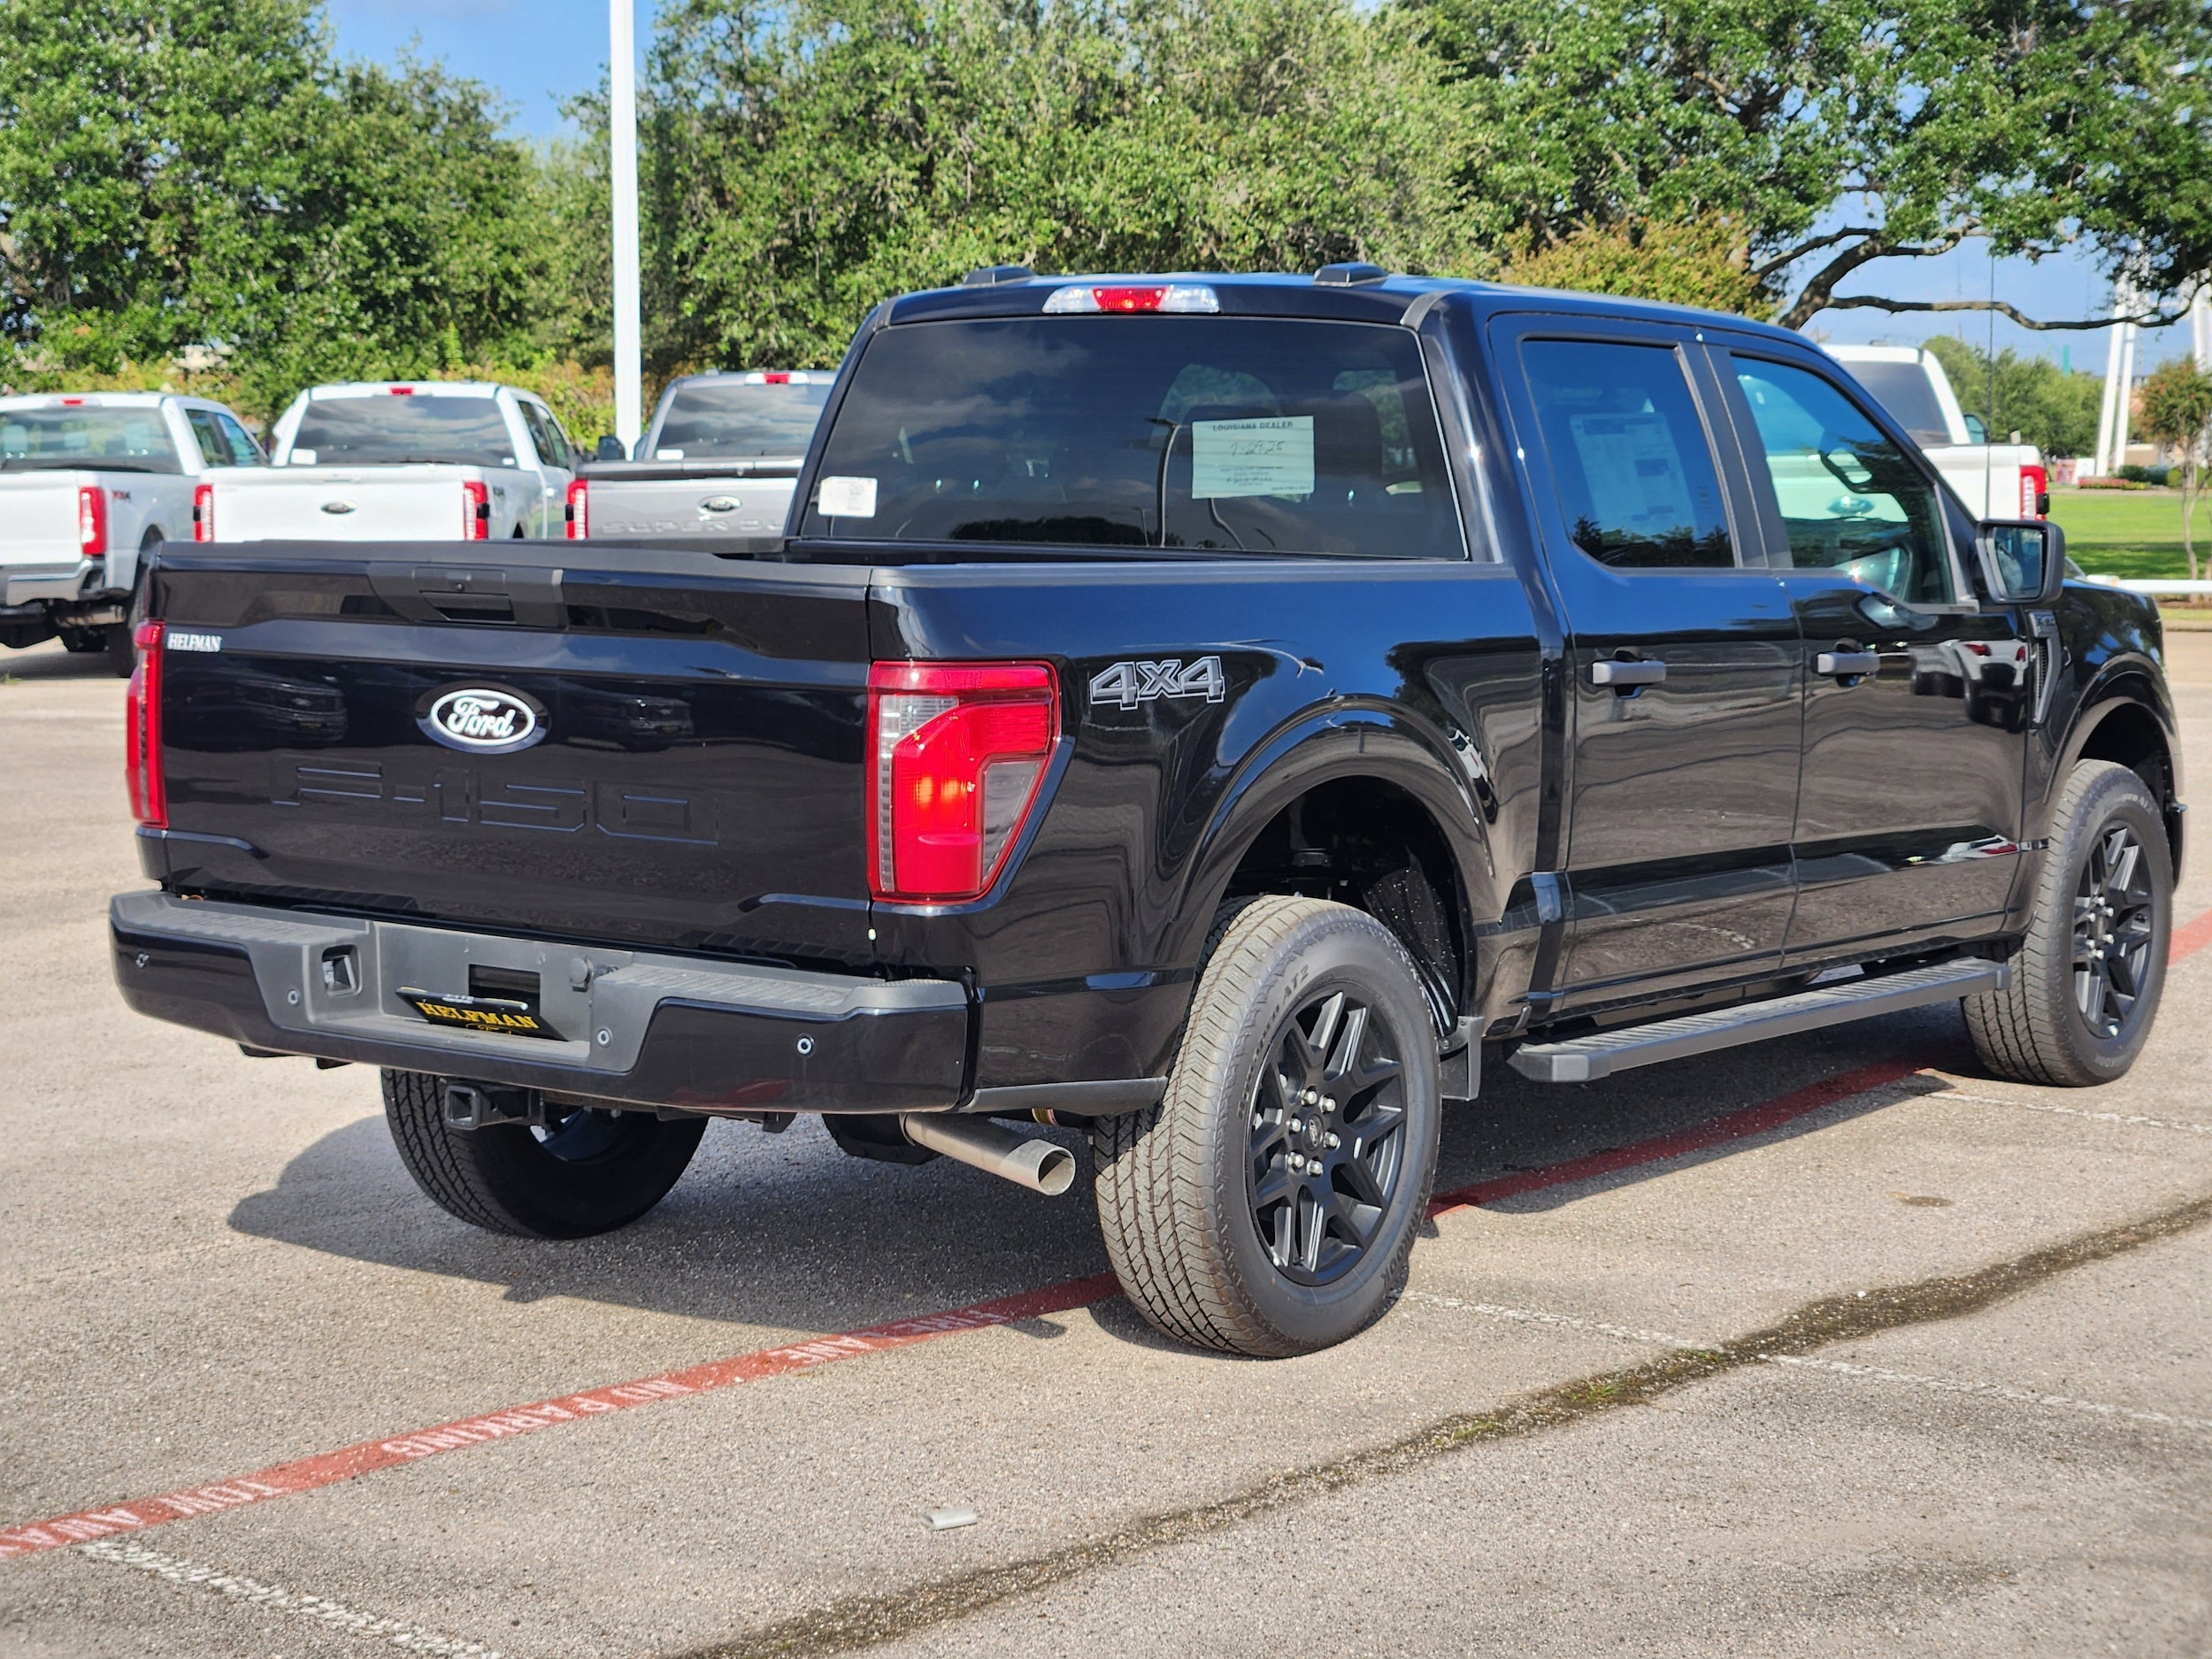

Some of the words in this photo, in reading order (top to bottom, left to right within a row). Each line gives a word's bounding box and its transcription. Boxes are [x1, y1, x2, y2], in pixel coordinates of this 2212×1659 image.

[1212, 422, 1257, 432] LOUISIANA
[1259, 420, 1294, 430] DEALER
[167, 632, 222, 652] HELFMAN
[446, 695, 516, 738] Ford
[268, 754, 719, 845] F-150
[416, 1002, 539, 1029] HELFMAN
